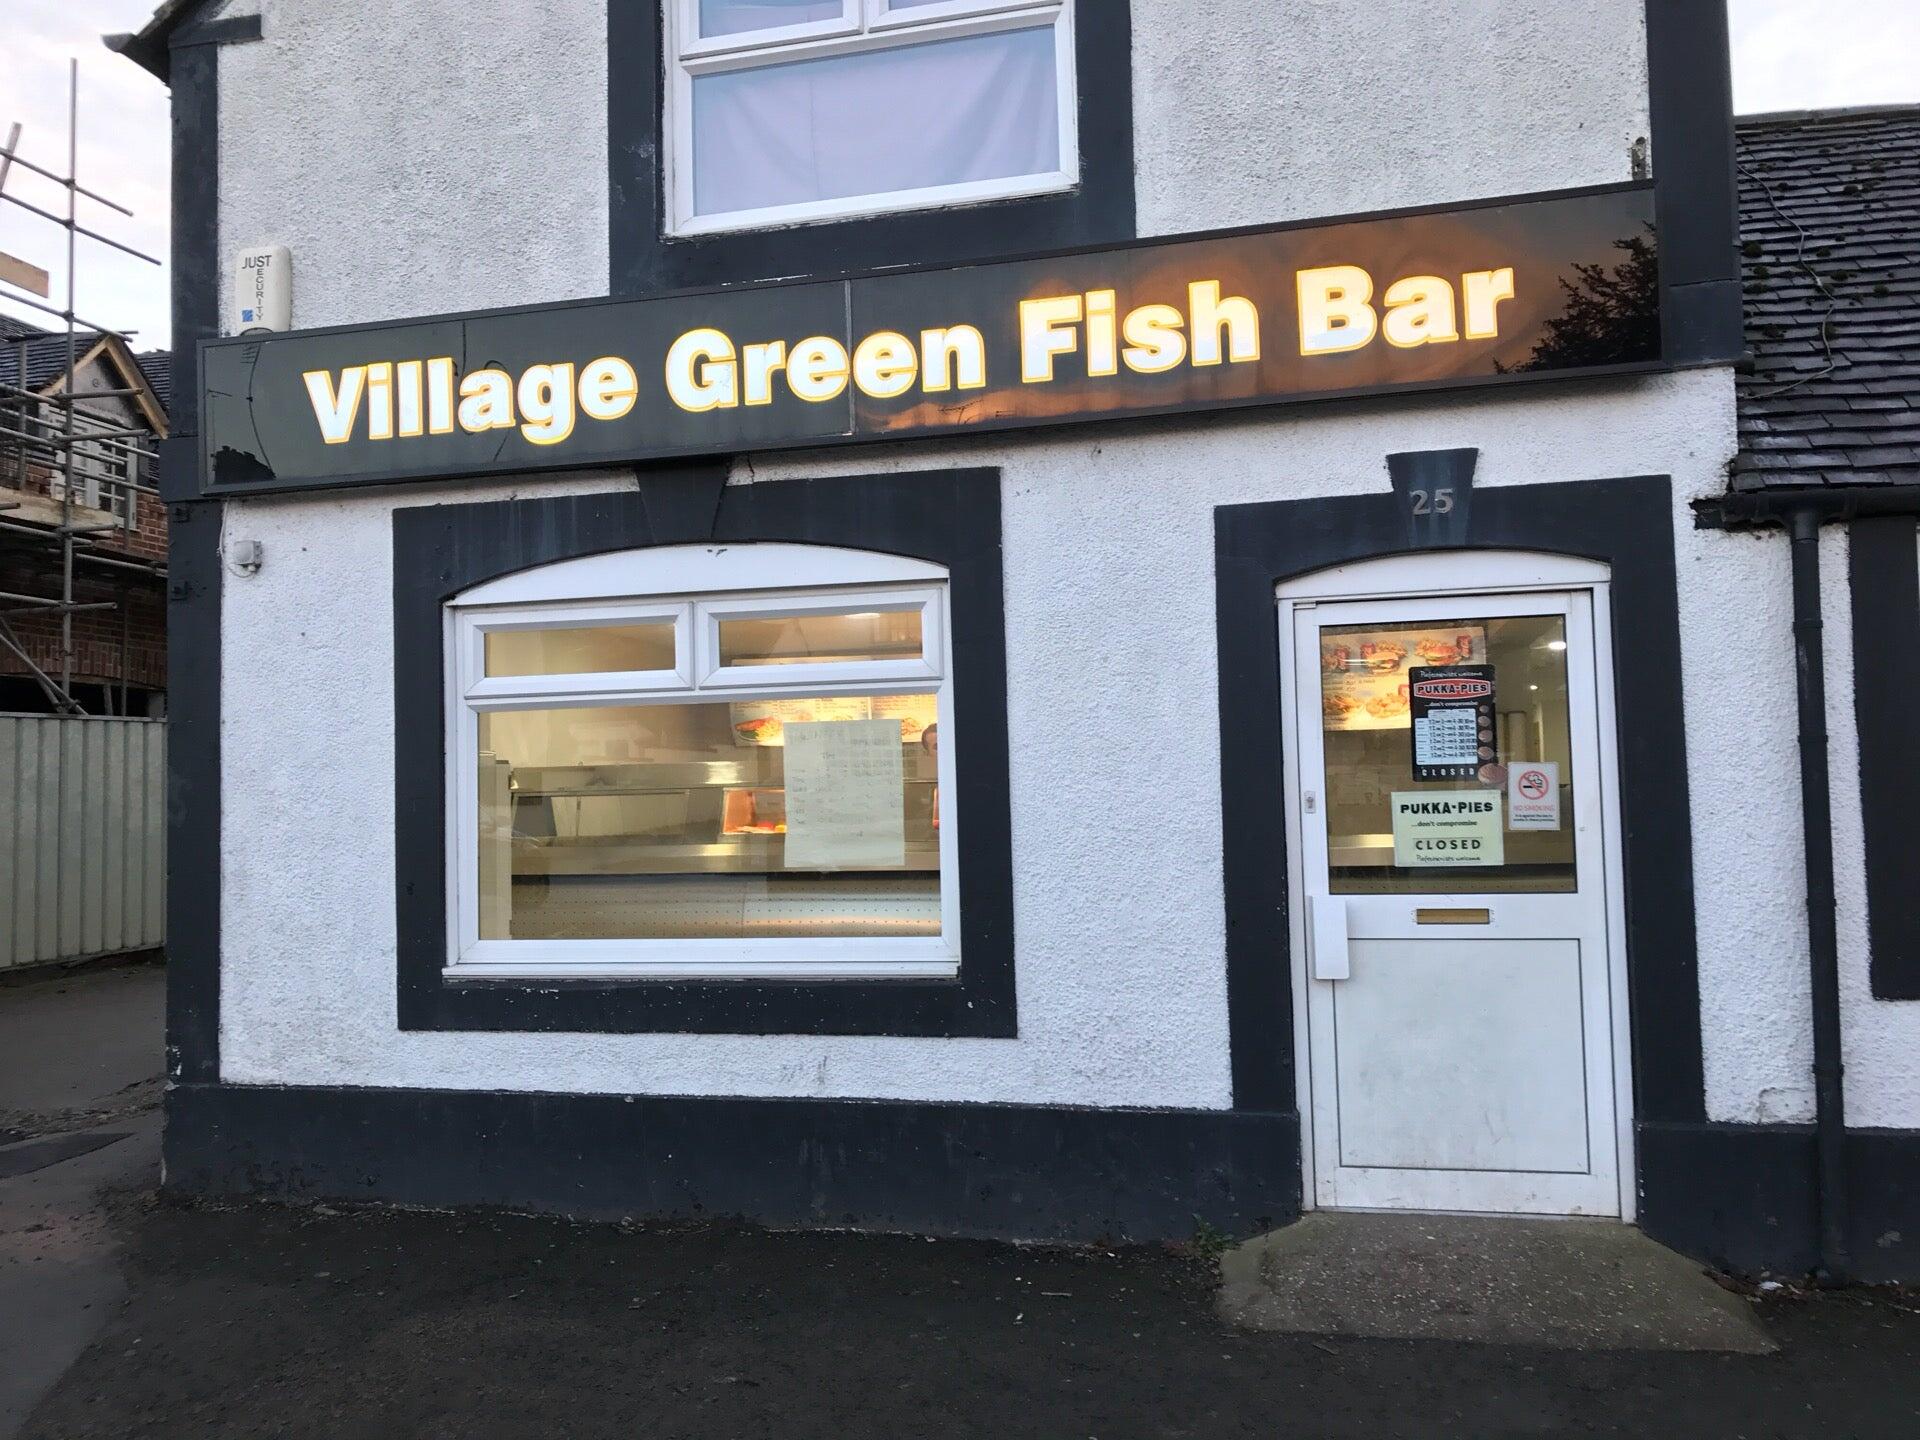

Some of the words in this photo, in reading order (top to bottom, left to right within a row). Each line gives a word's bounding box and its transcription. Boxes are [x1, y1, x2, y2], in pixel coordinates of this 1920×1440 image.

[242, 254, 272, 269] JUST
[302, 356, 638, 445] Village
[665, 324, 986, 413] Green
[1019, 279, 1261, 384] Fish
[1295, 265, 1515, 357] Bar
[1409, 488, 1454, 515] 25
[1421, 767, 1475, 777] CLOSED
[1415, 839, 1481, 851] CLOSED
